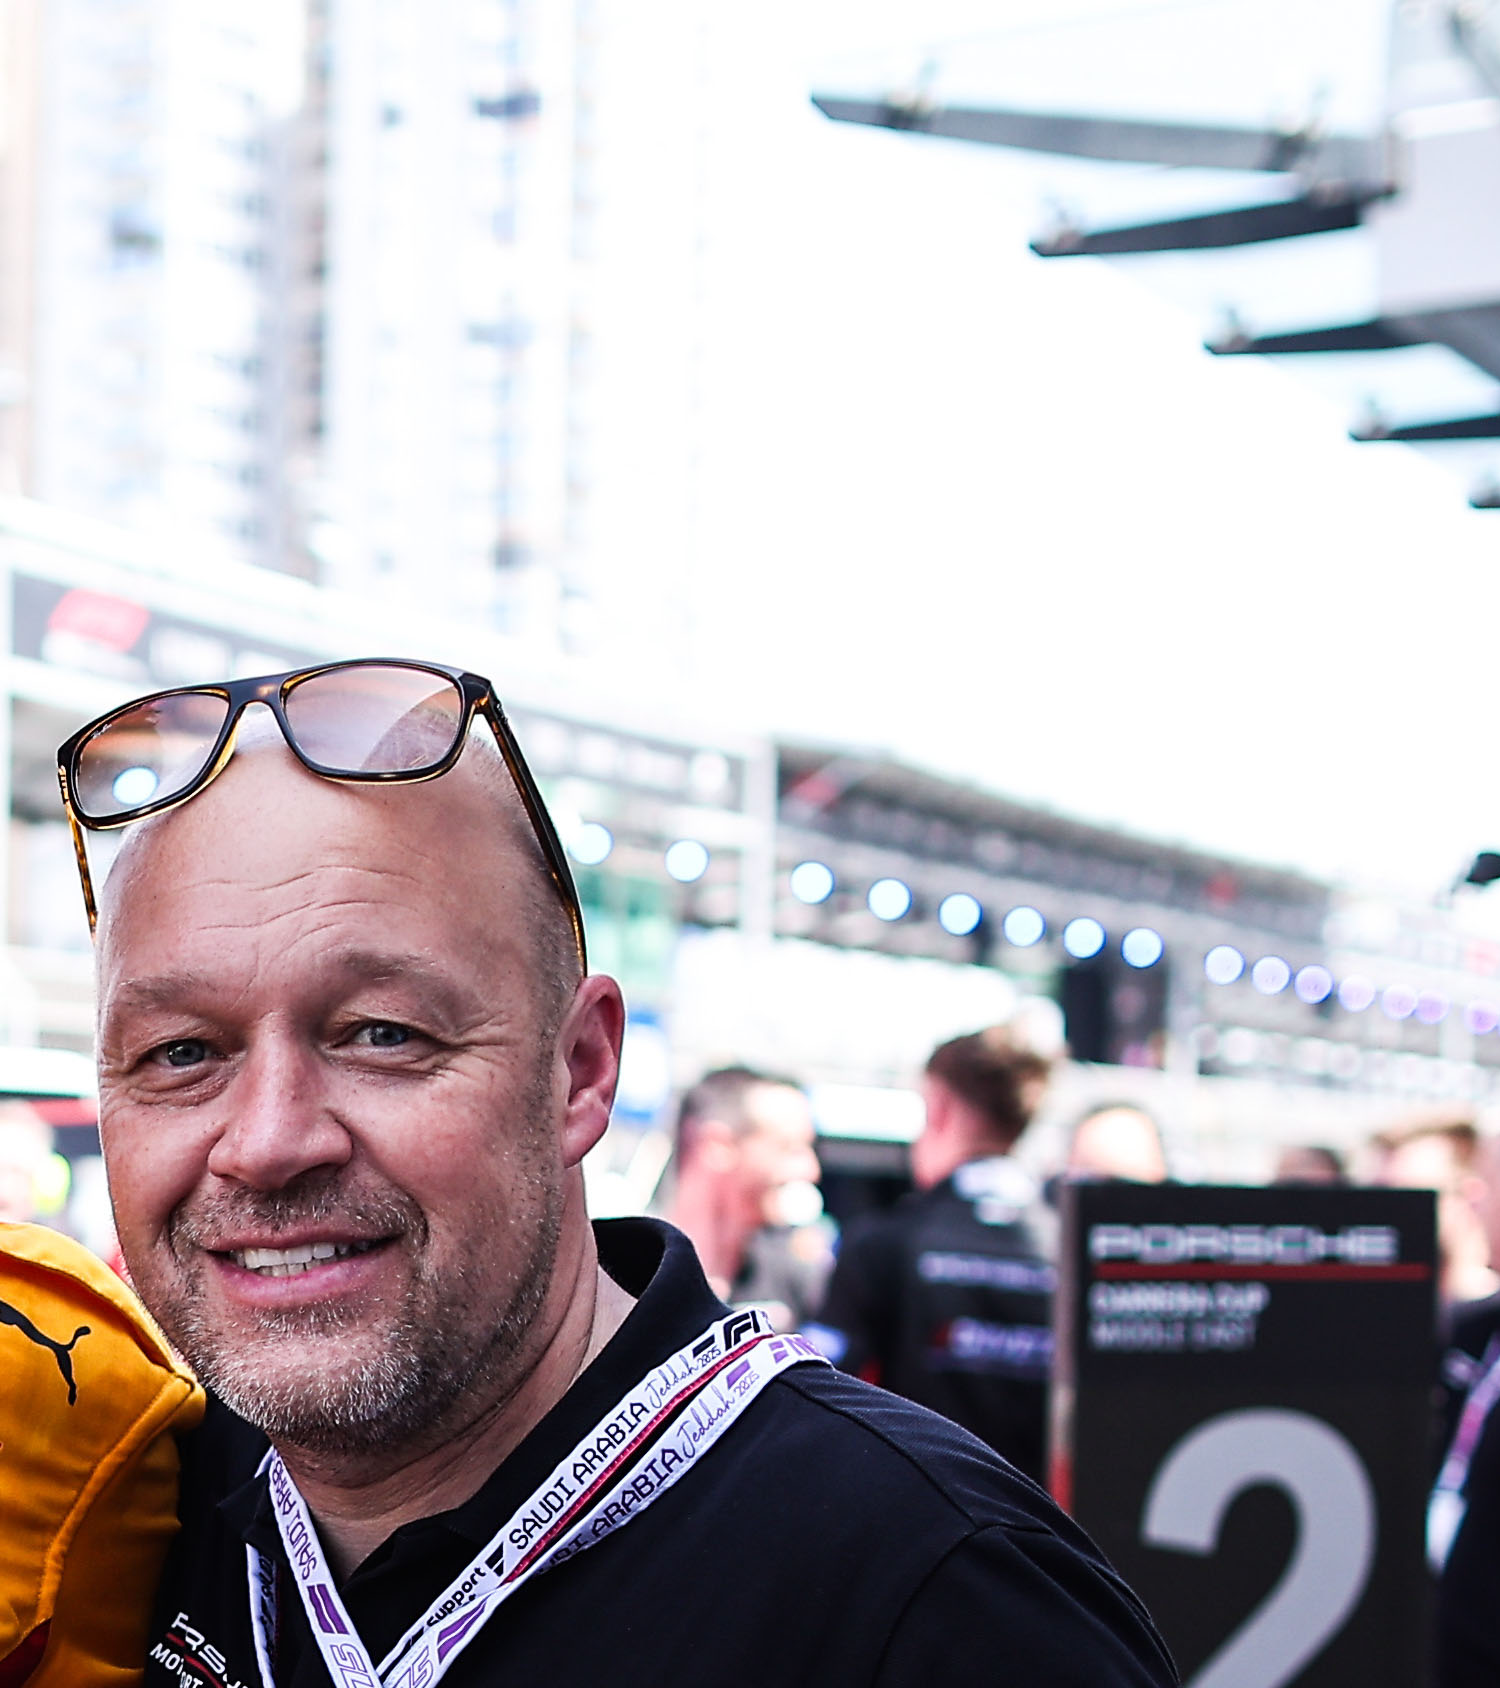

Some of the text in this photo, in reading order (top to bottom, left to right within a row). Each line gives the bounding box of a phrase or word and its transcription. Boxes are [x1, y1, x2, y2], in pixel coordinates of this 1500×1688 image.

[1090, 1224, 1398, 1265] PORSCHE
[509, 1477, 576, 1550] SAUDI
[572, 1402, 650, 1485] ARABIA
[644, 1354, 699, 1409] Jeddah
[591, 1448, 685, 1539] ARABIA
[676, 1384, 735, 1459] Jeddah
